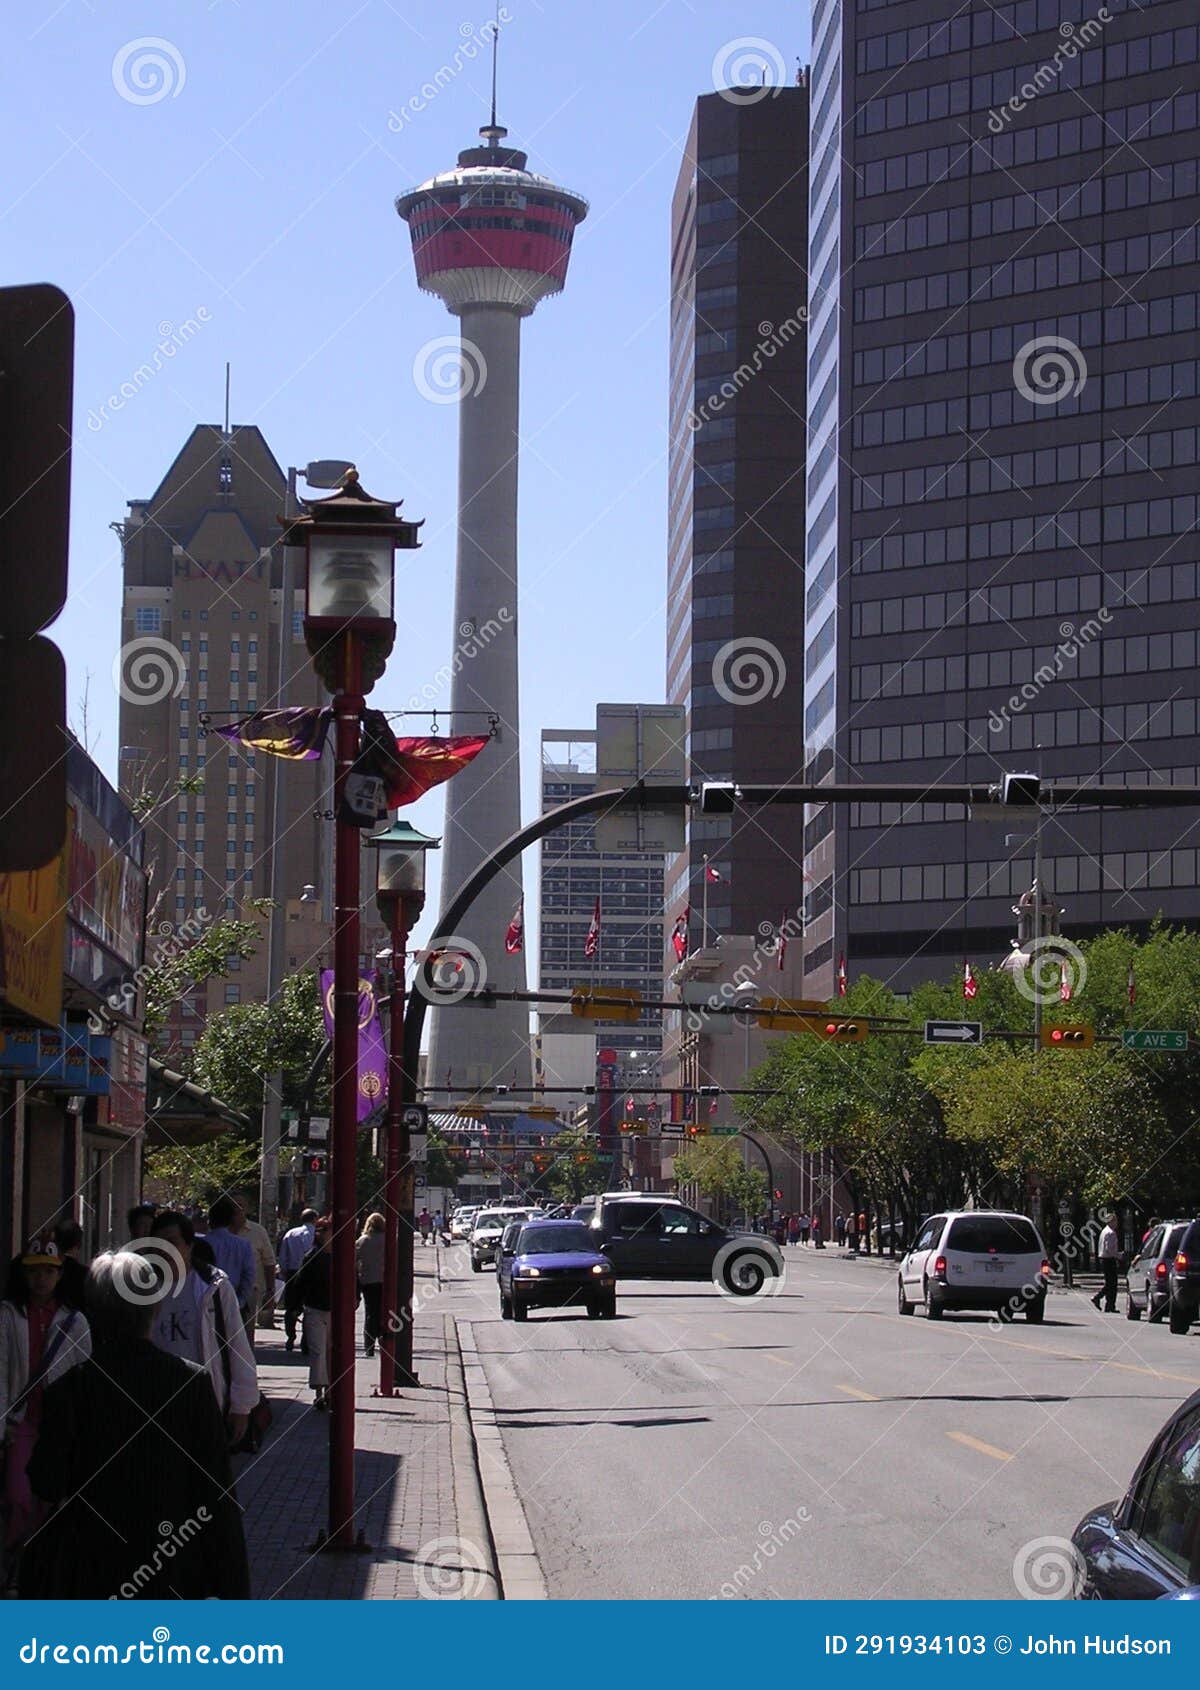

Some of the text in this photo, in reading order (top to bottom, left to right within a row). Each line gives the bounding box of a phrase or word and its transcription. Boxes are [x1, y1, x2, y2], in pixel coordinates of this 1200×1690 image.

[175, 559, 264, 581] HYATT
[1143, 1035, 1167, 1046] AVE
[1175, 1035, 1184, 1046] S
